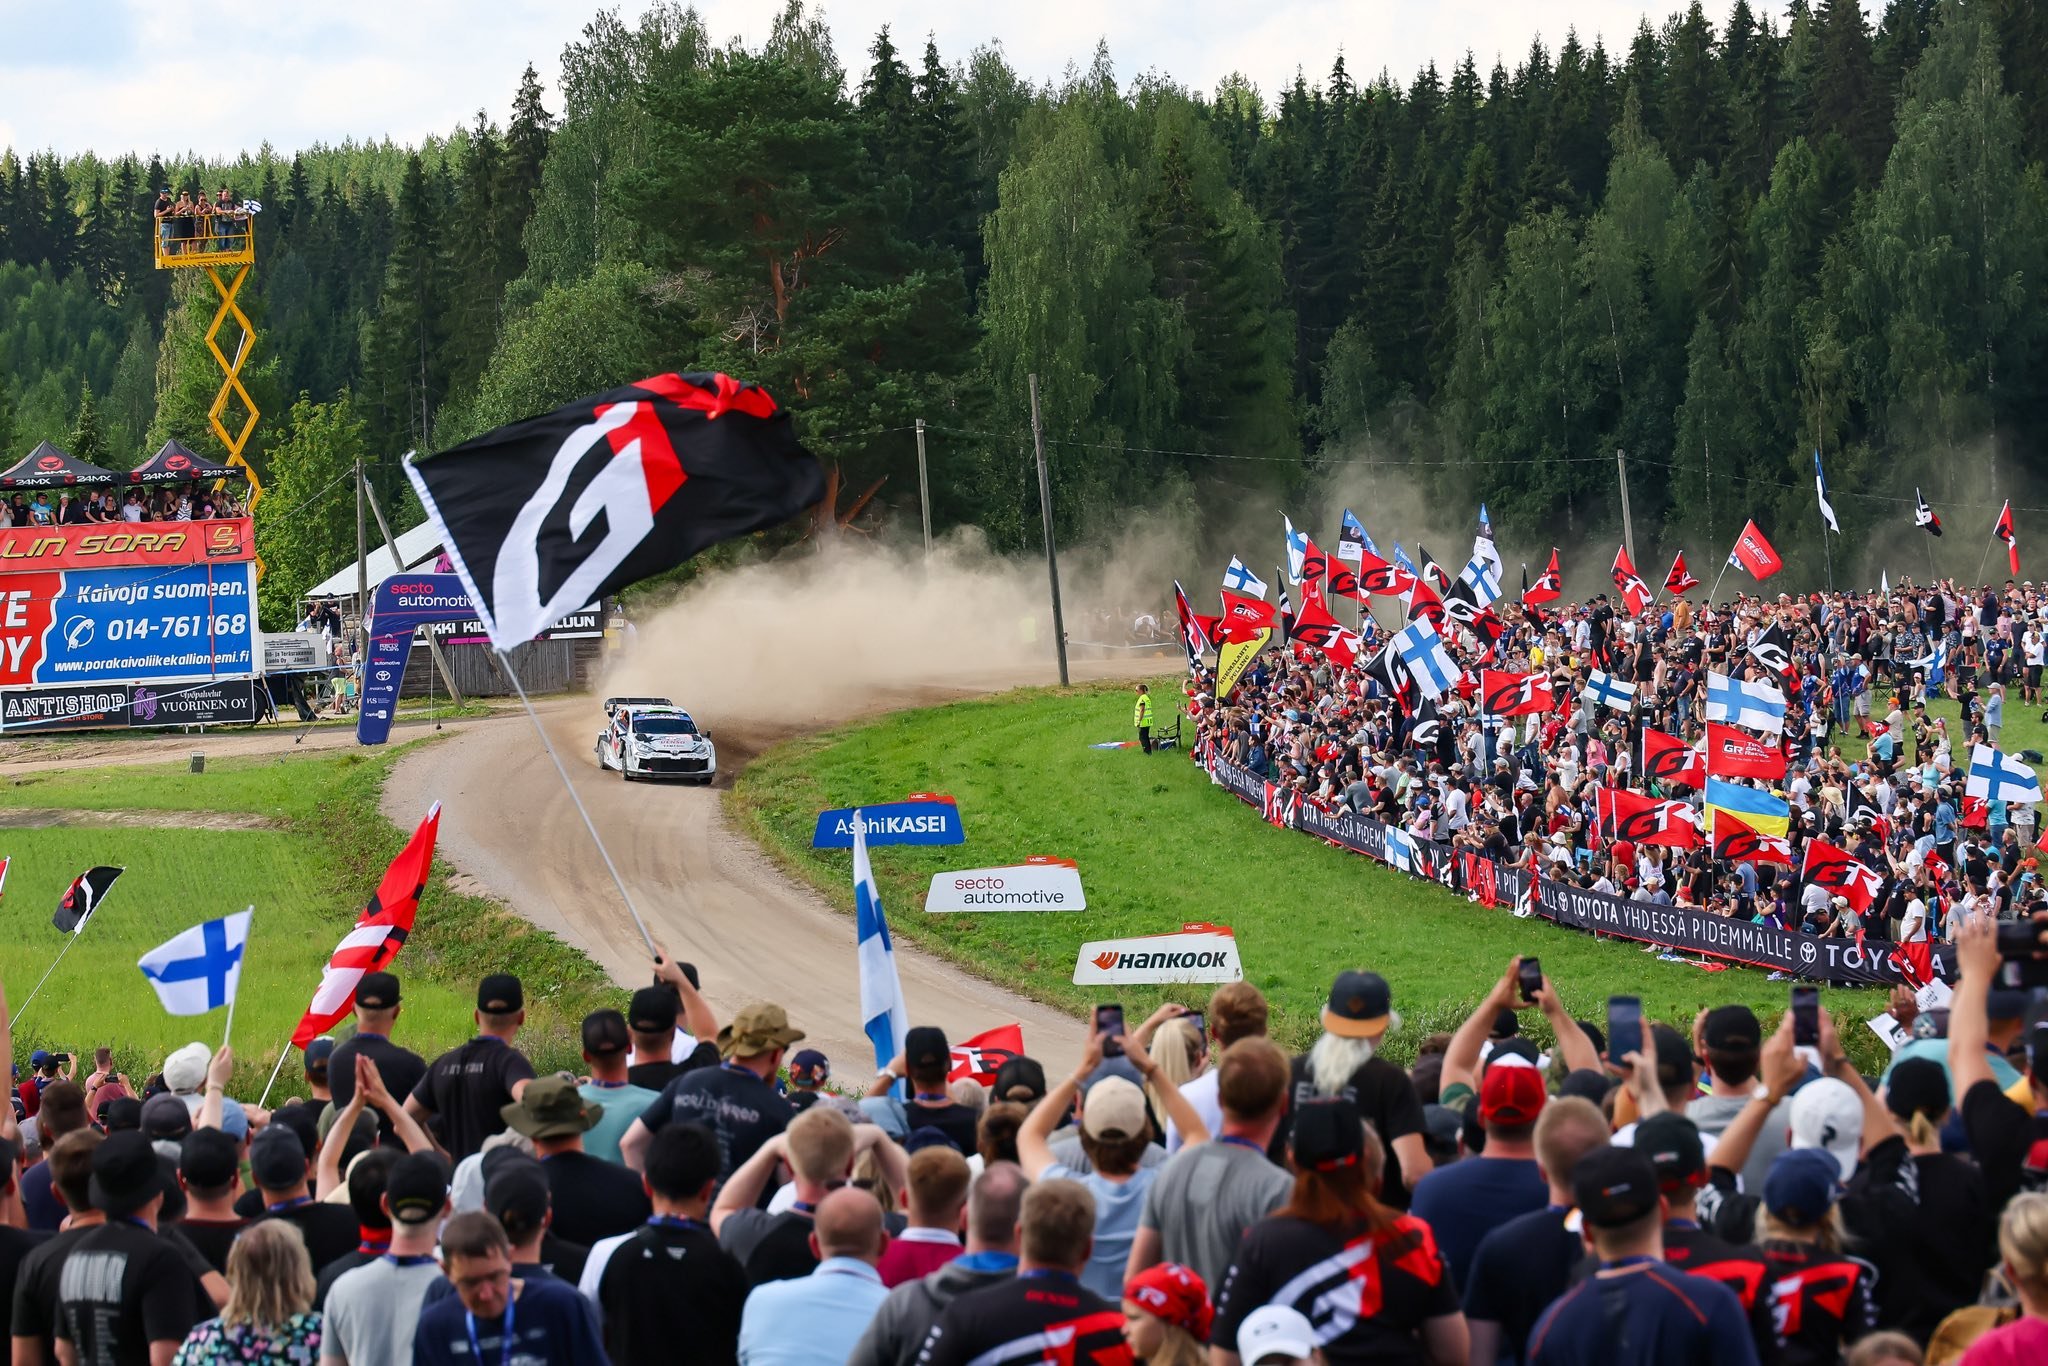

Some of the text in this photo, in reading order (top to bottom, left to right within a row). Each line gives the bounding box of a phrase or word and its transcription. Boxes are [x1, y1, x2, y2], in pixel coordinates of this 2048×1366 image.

[143, 471, 178, 480] 24MX
[202, 469, 237, 477] 24MX
[0, 533, 187, 558] LIN SORA
[77, 582, 247, 605] Kaivoja suomeen.
[391, 583, 434, 594] secto
[399, 595, 473, 607] automotiv
[107, 614, 247, 640] 014-761 168
[5, 693, 127, 718] ANTISHOP
[162, 698, 248, 713] VUORINEN OY
[954, 876, 1004, 890] secto
[963, 890, 1064, 905] automotive
[1571, 894, 1619, 924] TOYOTA
[1622, 906, 1687, 938] YHDESSÄ
[1692, 918, 1793, 960] PIDEMMÄLLE
[1825, 944, 1947, 976] TOYA
